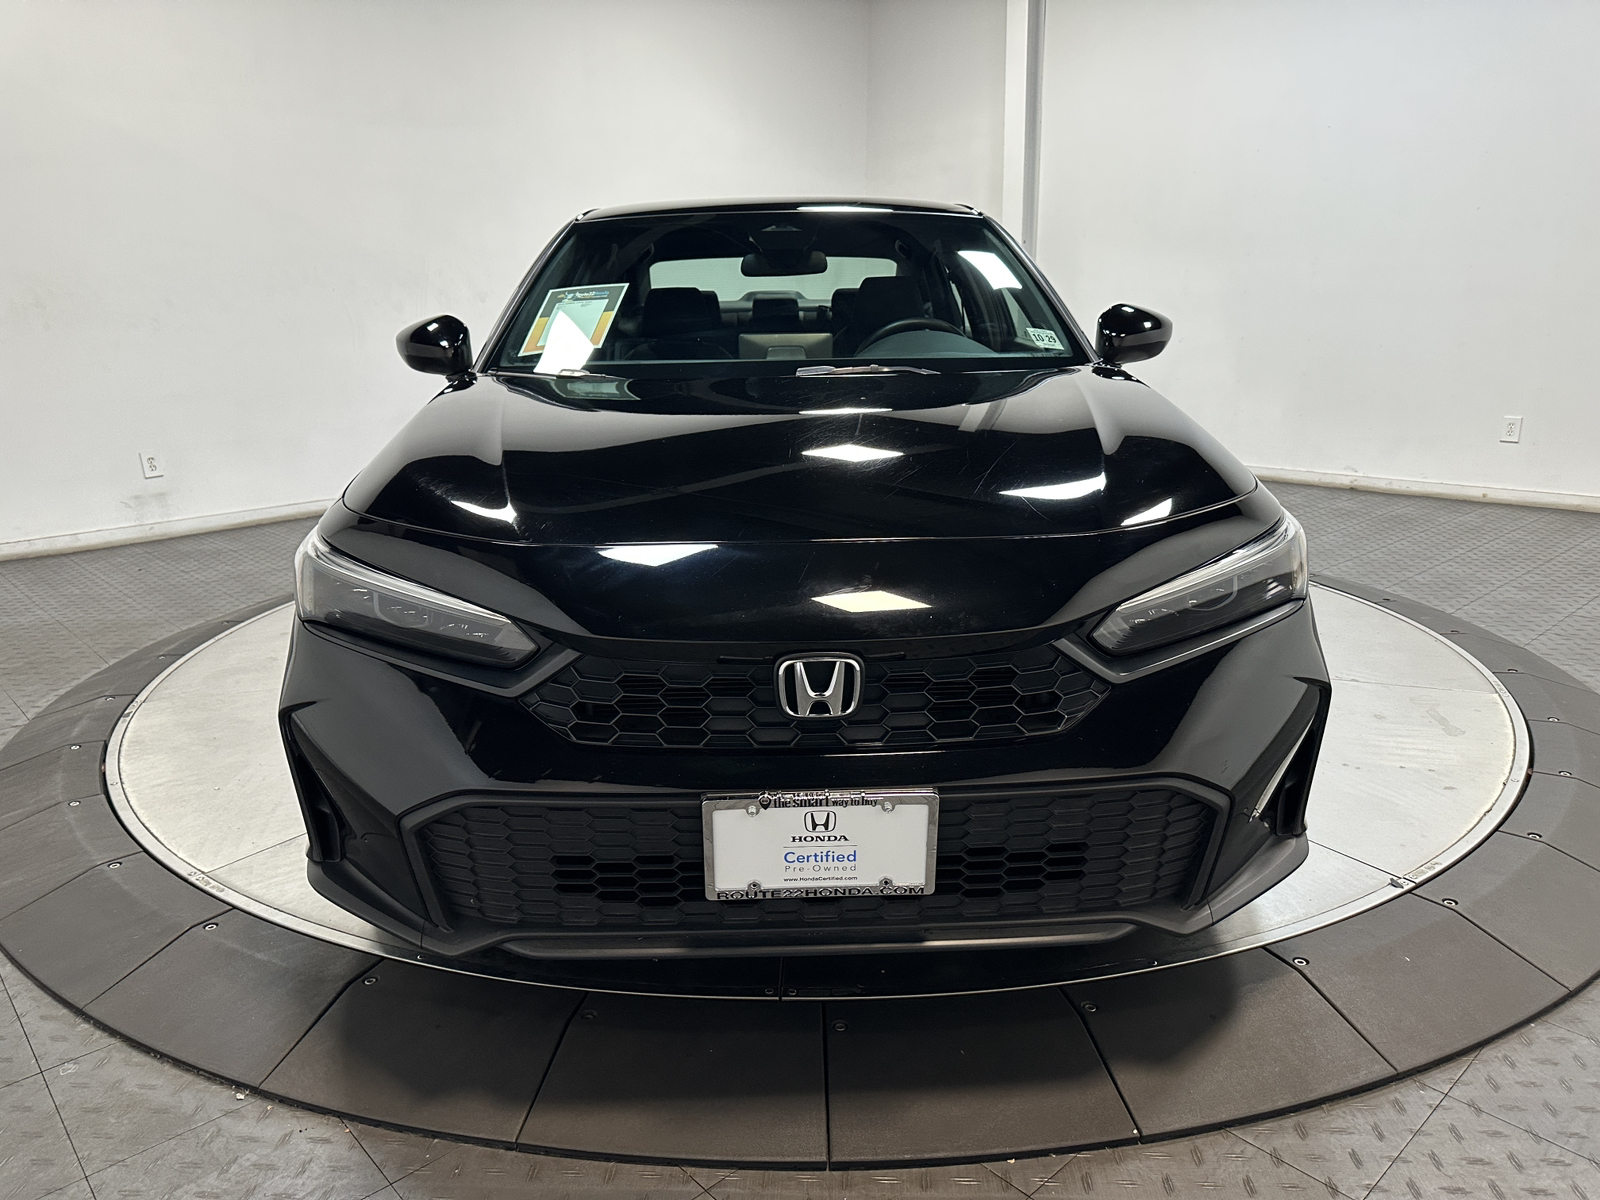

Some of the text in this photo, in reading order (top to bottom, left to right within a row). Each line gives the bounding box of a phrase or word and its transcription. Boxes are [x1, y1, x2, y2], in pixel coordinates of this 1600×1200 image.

[1032, 333, 1057, 343] 10 29
[773, 796, 791, 808] the
[792, 795, 830, 808] smart
[832, 798, 849, 808] way
[850, 797, 860, 806] to
[790, 835, 849, 843] HONDA
[783, 850, 857, 864] Certified
[784, 864, 857, 873] Pre-Owned
[716, 886, 925, 900] ROUTE22HONDA.COM
